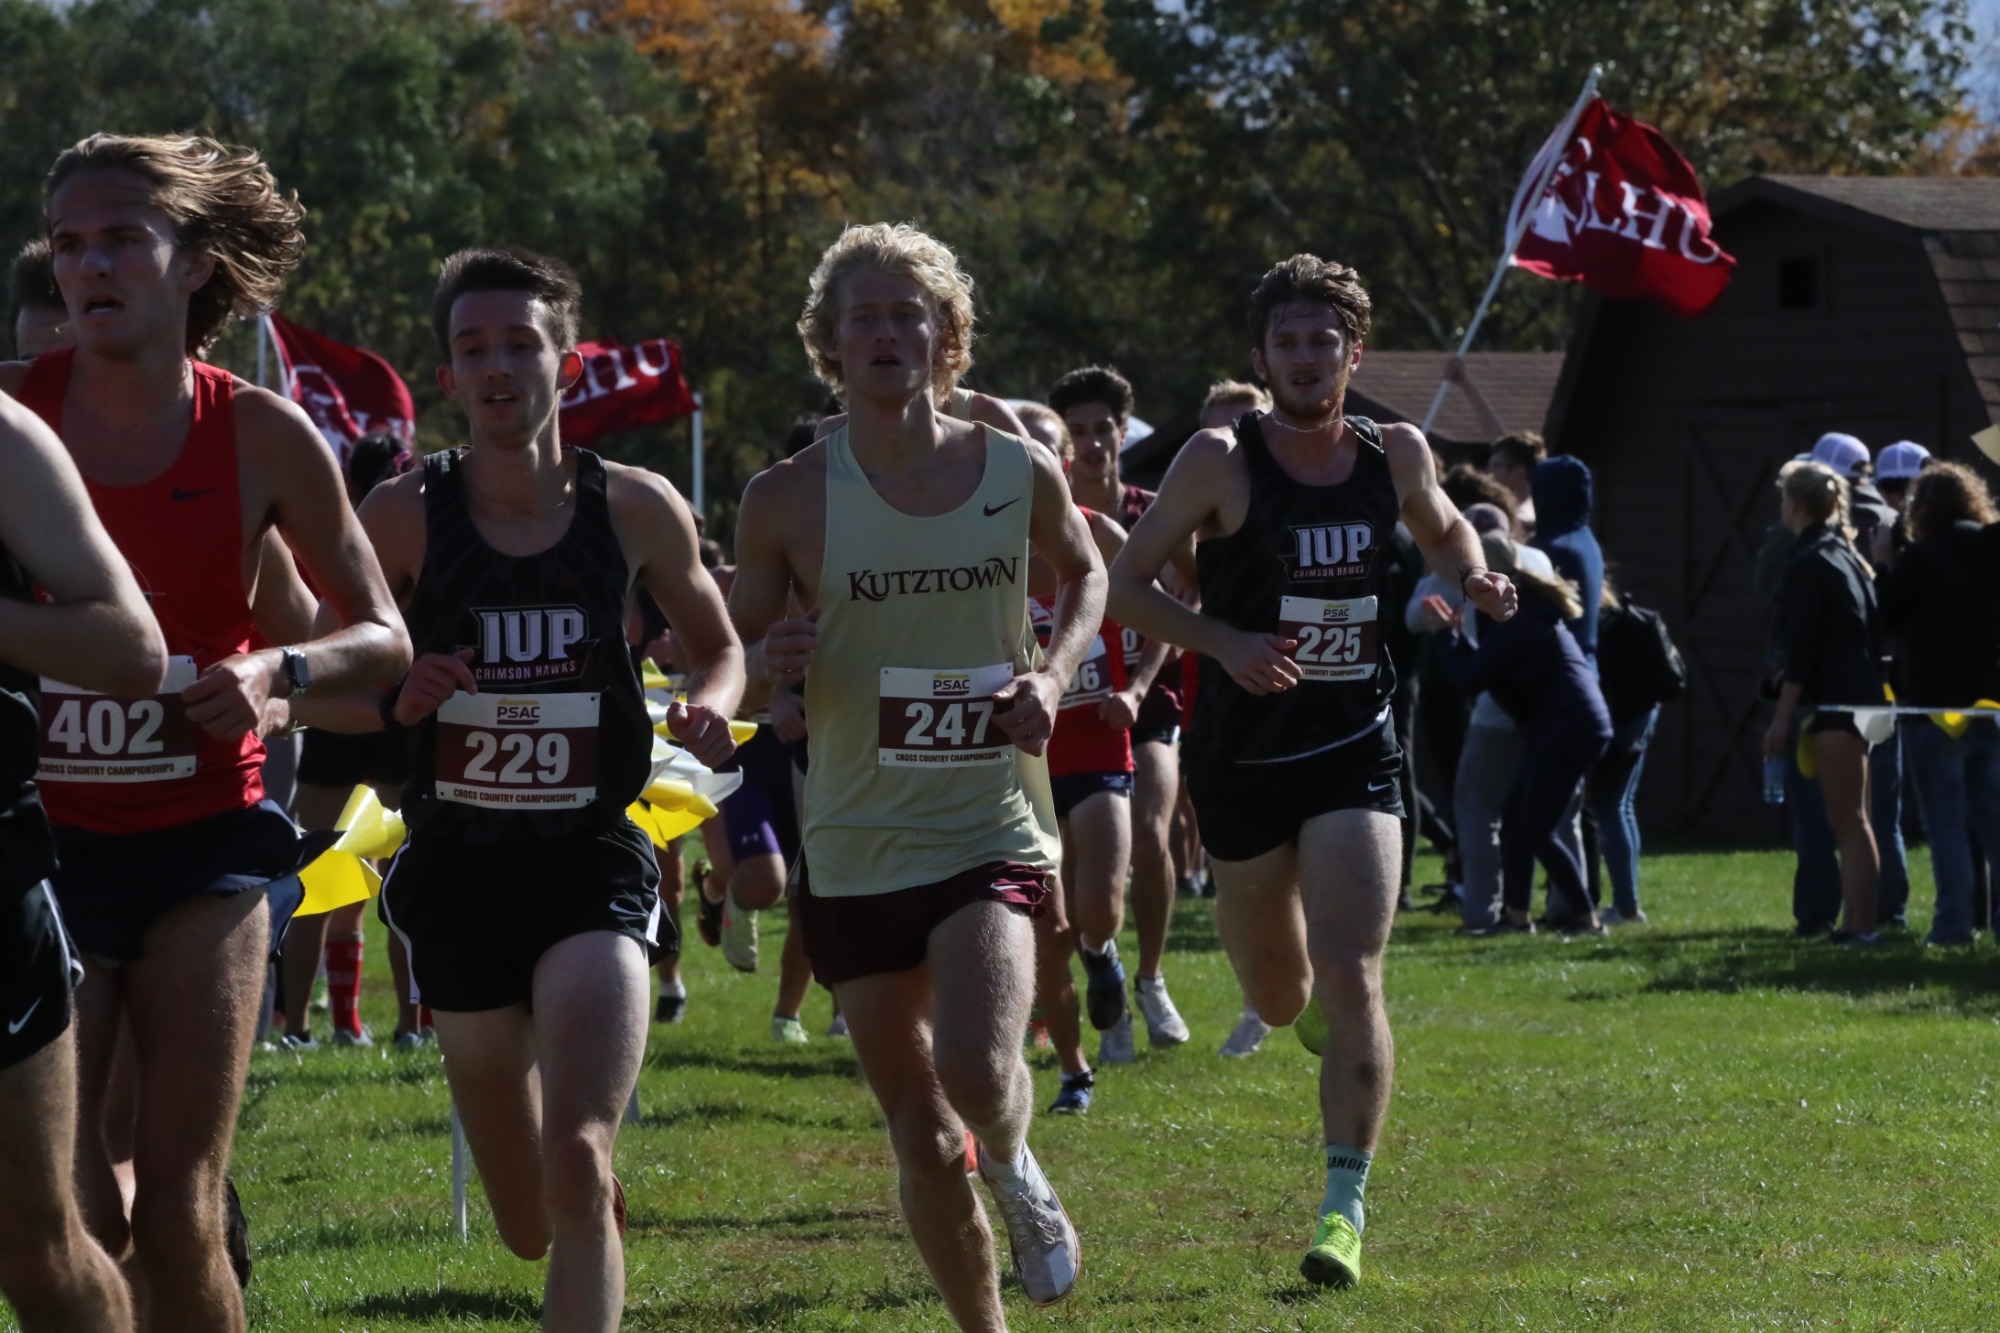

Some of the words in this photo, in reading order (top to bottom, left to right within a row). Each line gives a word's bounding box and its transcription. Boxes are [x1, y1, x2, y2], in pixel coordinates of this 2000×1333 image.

[1295, 523, 1372, 568] IUP
[847, 557, 1018, 602] KUTZTOWN
[1293, 567, 1335, 579] CRIMSON
[1337, 564, 1365, 576] HAWKS
[1323, 608, 1350, 617] PSAC
[480, 609, 585, 664] IUP
[1295, 625, 1362, 663] 225
[475, 667, 531, 681] CRIMSON
[535, 660, 576, 677] HAWKS
[933, 679, 970, 690] PSAC
[497, 706, 540, 719] PSAC
[48, 700, 164, 756] 402
[904, 702, 995, 746] 247
[463, 731, 571, 784] 229
[896, 753, 917, 762] CROSS
[919, 755, 948, 763] COUNTRY
[950, 751, 1001, 763] CHAMPIONSHIPS
[39, 764, 65, 774] CROSS
[67, 765, 105, 775] COUNTRY
[107, 763, 175, 776] CHAMPIONSHIPS
[453, 788, 478, 800] CROSS
[480, 792, 513, 803] COUNTRY
[516, 793, 577, 804] CHAMPIONSHIPS
